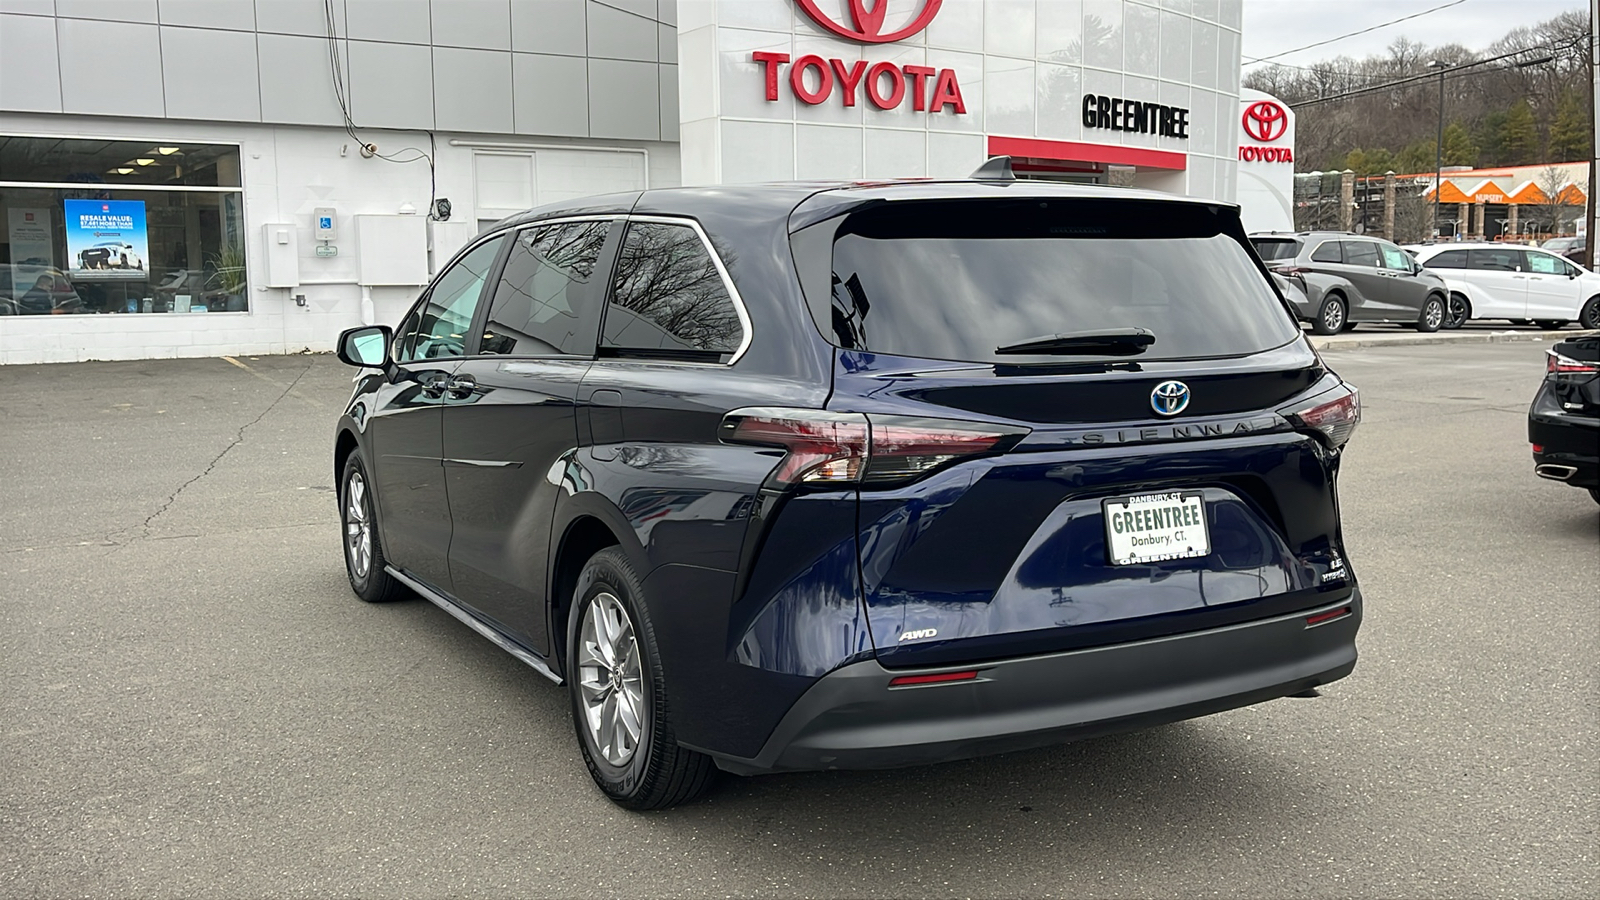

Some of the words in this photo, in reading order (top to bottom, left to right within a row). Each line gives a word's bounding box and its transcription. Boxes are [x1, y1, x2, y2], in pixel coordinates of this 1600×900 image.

[752, 51, 967, 114] TOYOTA
[1082, 94, 1189, 138] GREENTREE
[1475, 193, 1504, 203] NURSERY
[1082, 422, 1251, 445] SIENNA
[1171, 492, 1181, 501] CT
[1112, 504, 1200, 534] GREENTREE
[1131, 533, 1172, 547] Danbury,
[1175, 530, 1187, 542] CT.
[1119, 550, 1207, 566] GREENTREE
[1330, 558, 1343, 569] LE
[898, 628, 938, 642] AWD
